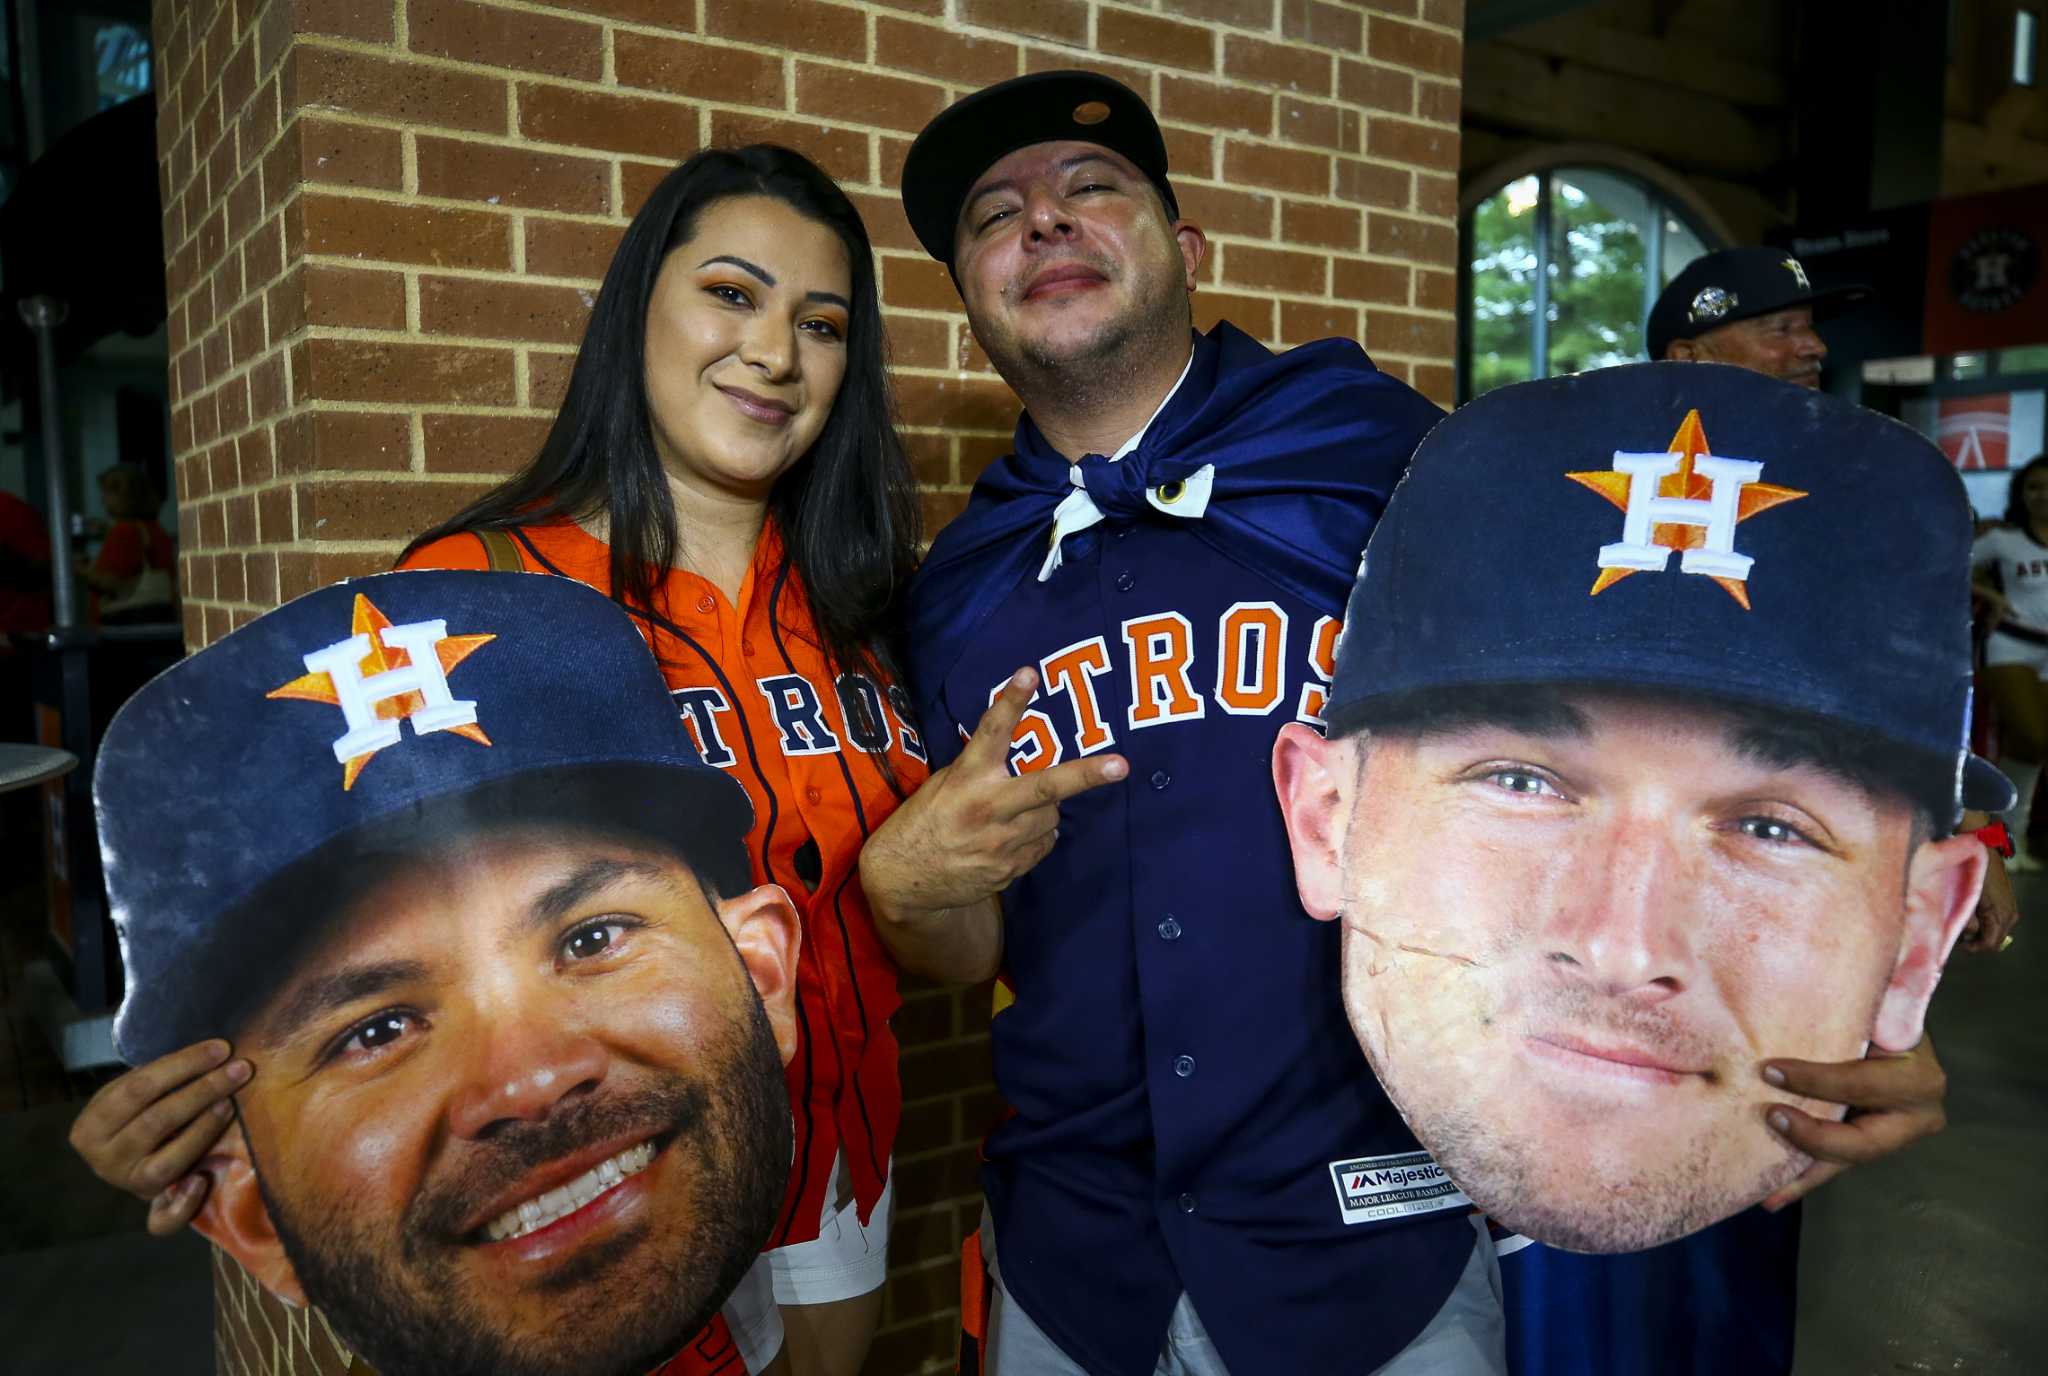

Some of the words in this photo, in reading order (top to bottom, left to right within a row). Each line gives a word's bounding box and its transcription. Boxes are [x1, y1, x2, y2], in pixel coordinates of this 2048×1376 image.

[1597, 450, 1765, 581] H
[303, 618, 478, 764] H
[671, 672, 928, 769] TROS
[958, 600, 1343, 777] STRO
[1350, 1195, 1380, 1208] MAJOR
[1380, 1190, 1415, 1203] LEAGUE
[1375, 1165, 1445, 1187] Majestic
